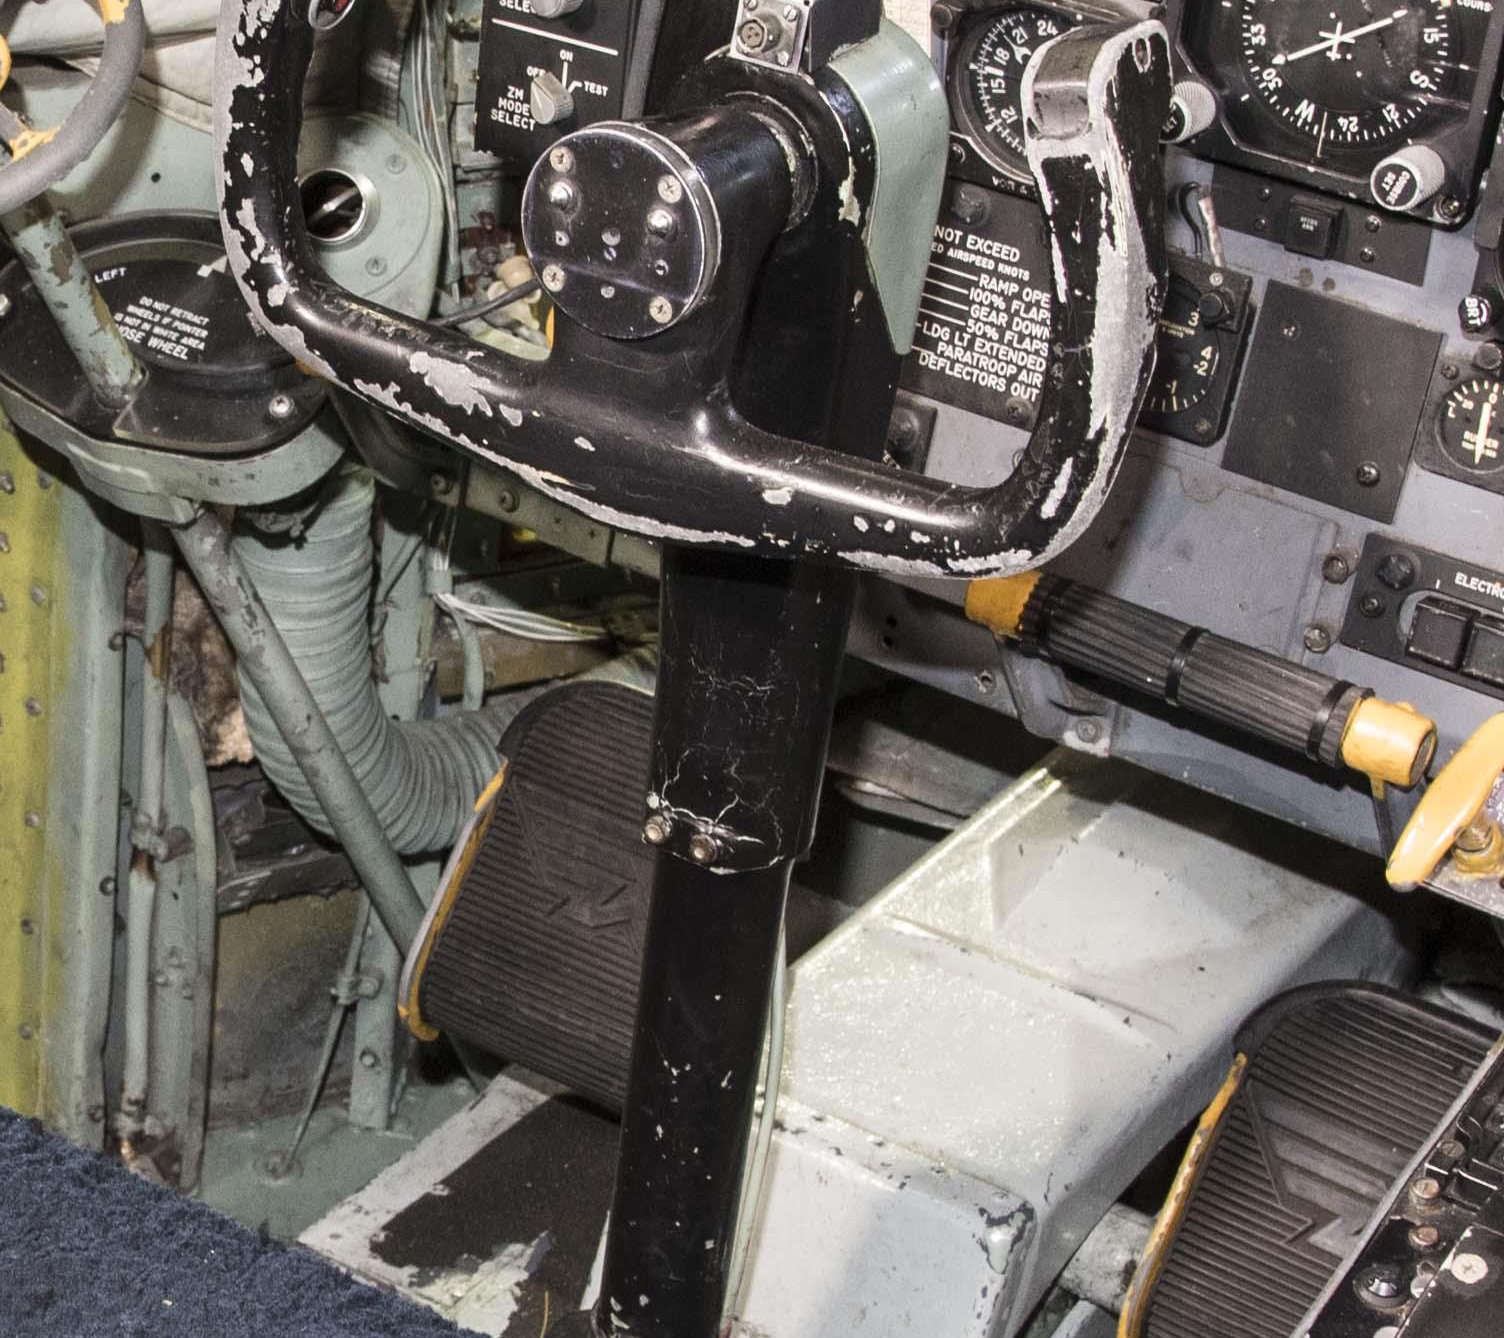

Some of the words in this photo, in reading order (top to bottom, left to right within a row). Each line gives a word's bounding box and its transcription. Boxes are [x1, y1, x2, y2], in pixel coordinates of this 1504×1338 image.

[560, 50, 573, 61] ON
[508, 86, 524, 100] ZM
[584, 81, 608, 97] TEST
[498, 98, 530, 116] MODE
[491, 109, 535, 131] SELECT
[934, 226, 963, 245] NOT
[966, 235, 1020, 262] EXCEED
[94, 267, 127, 283] LEFT
[947, 247, 995, 269] AIRSPEED
[998, 263, 1030, 281] KNOTS
[969, 287, 1006, 310] 100%
[147, 336, 188, 360] WHEEL
[923, 320, 950, 339] LDG
[954, 331, 970, 347] LT
[974, 338, 1046, 372] EXTENDED
[966, 320, 999, 340] 50%
[1004, 331, 1048, 356] FLAPS
[937, 342, 1017, 377] PARATROOP
[1018, 372, 1042, 388] AIR
[919, 352, 1006, 392] DEFLECTORS
[1010, 381, 1040, 402] OUT
